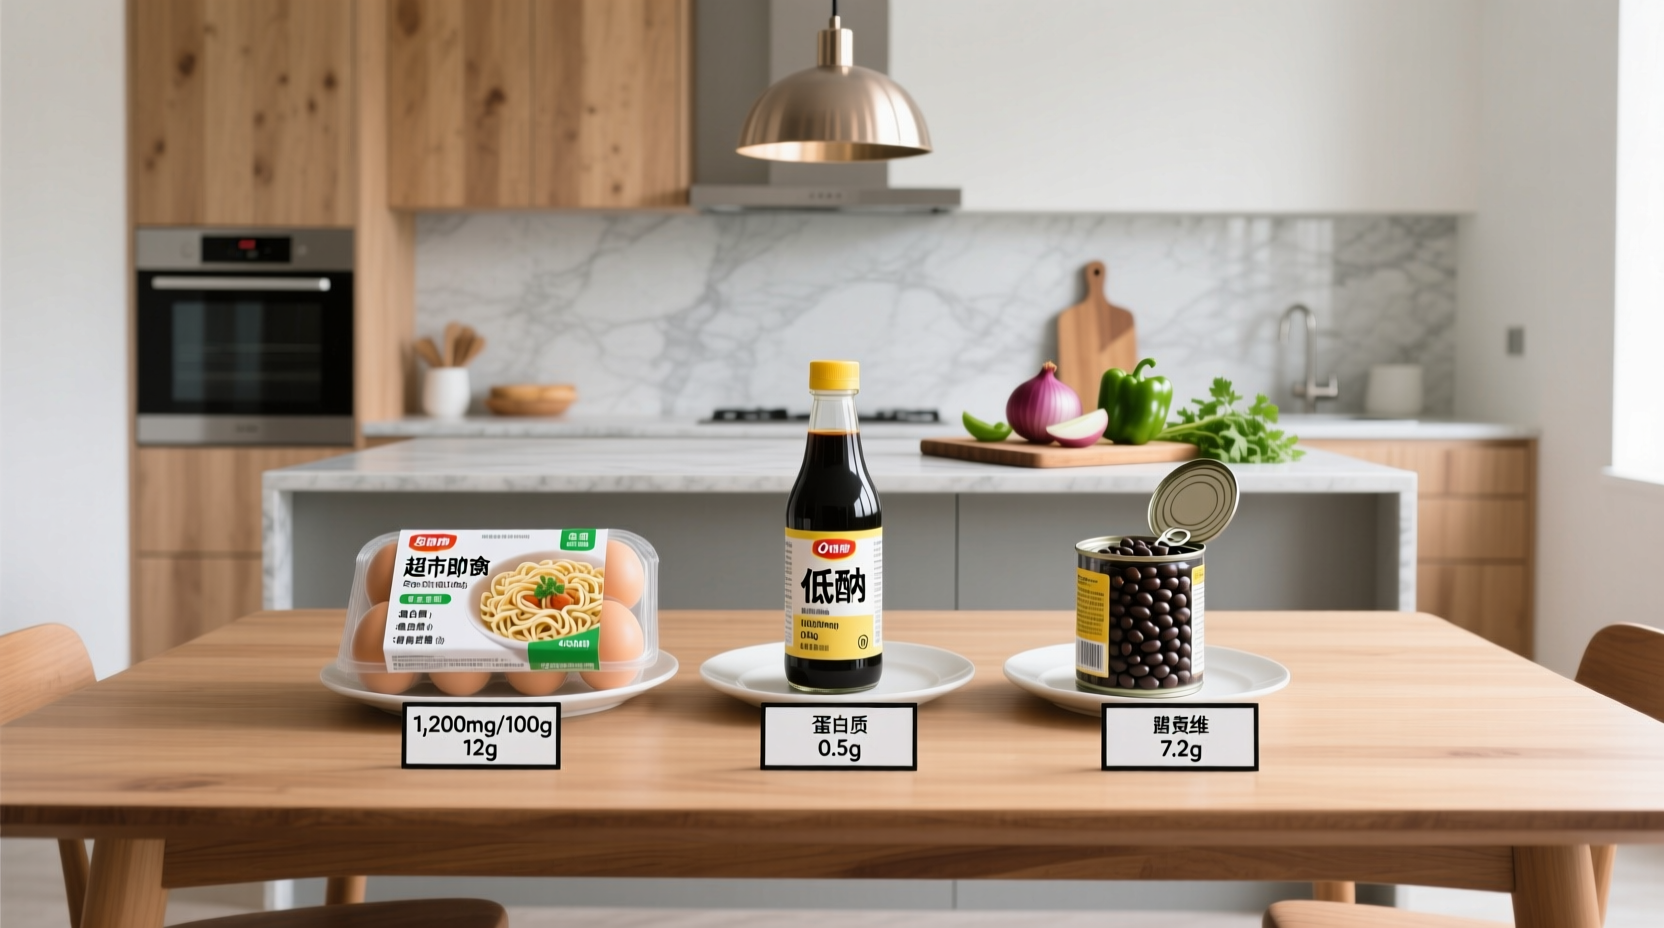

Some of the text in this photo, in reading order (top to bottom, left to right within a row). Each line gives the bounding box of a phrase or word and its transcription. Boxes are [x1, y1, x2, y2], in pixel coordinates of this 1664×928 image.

[413, 715, 552, 738] 1,200mg/100g
[811, 714, 868, 735] 蛋白质
[463, 738, 498, 762] 12g
[818, 739, 862, 762] 0.5g
[1160, 739, 1203, 762] 7.2g
